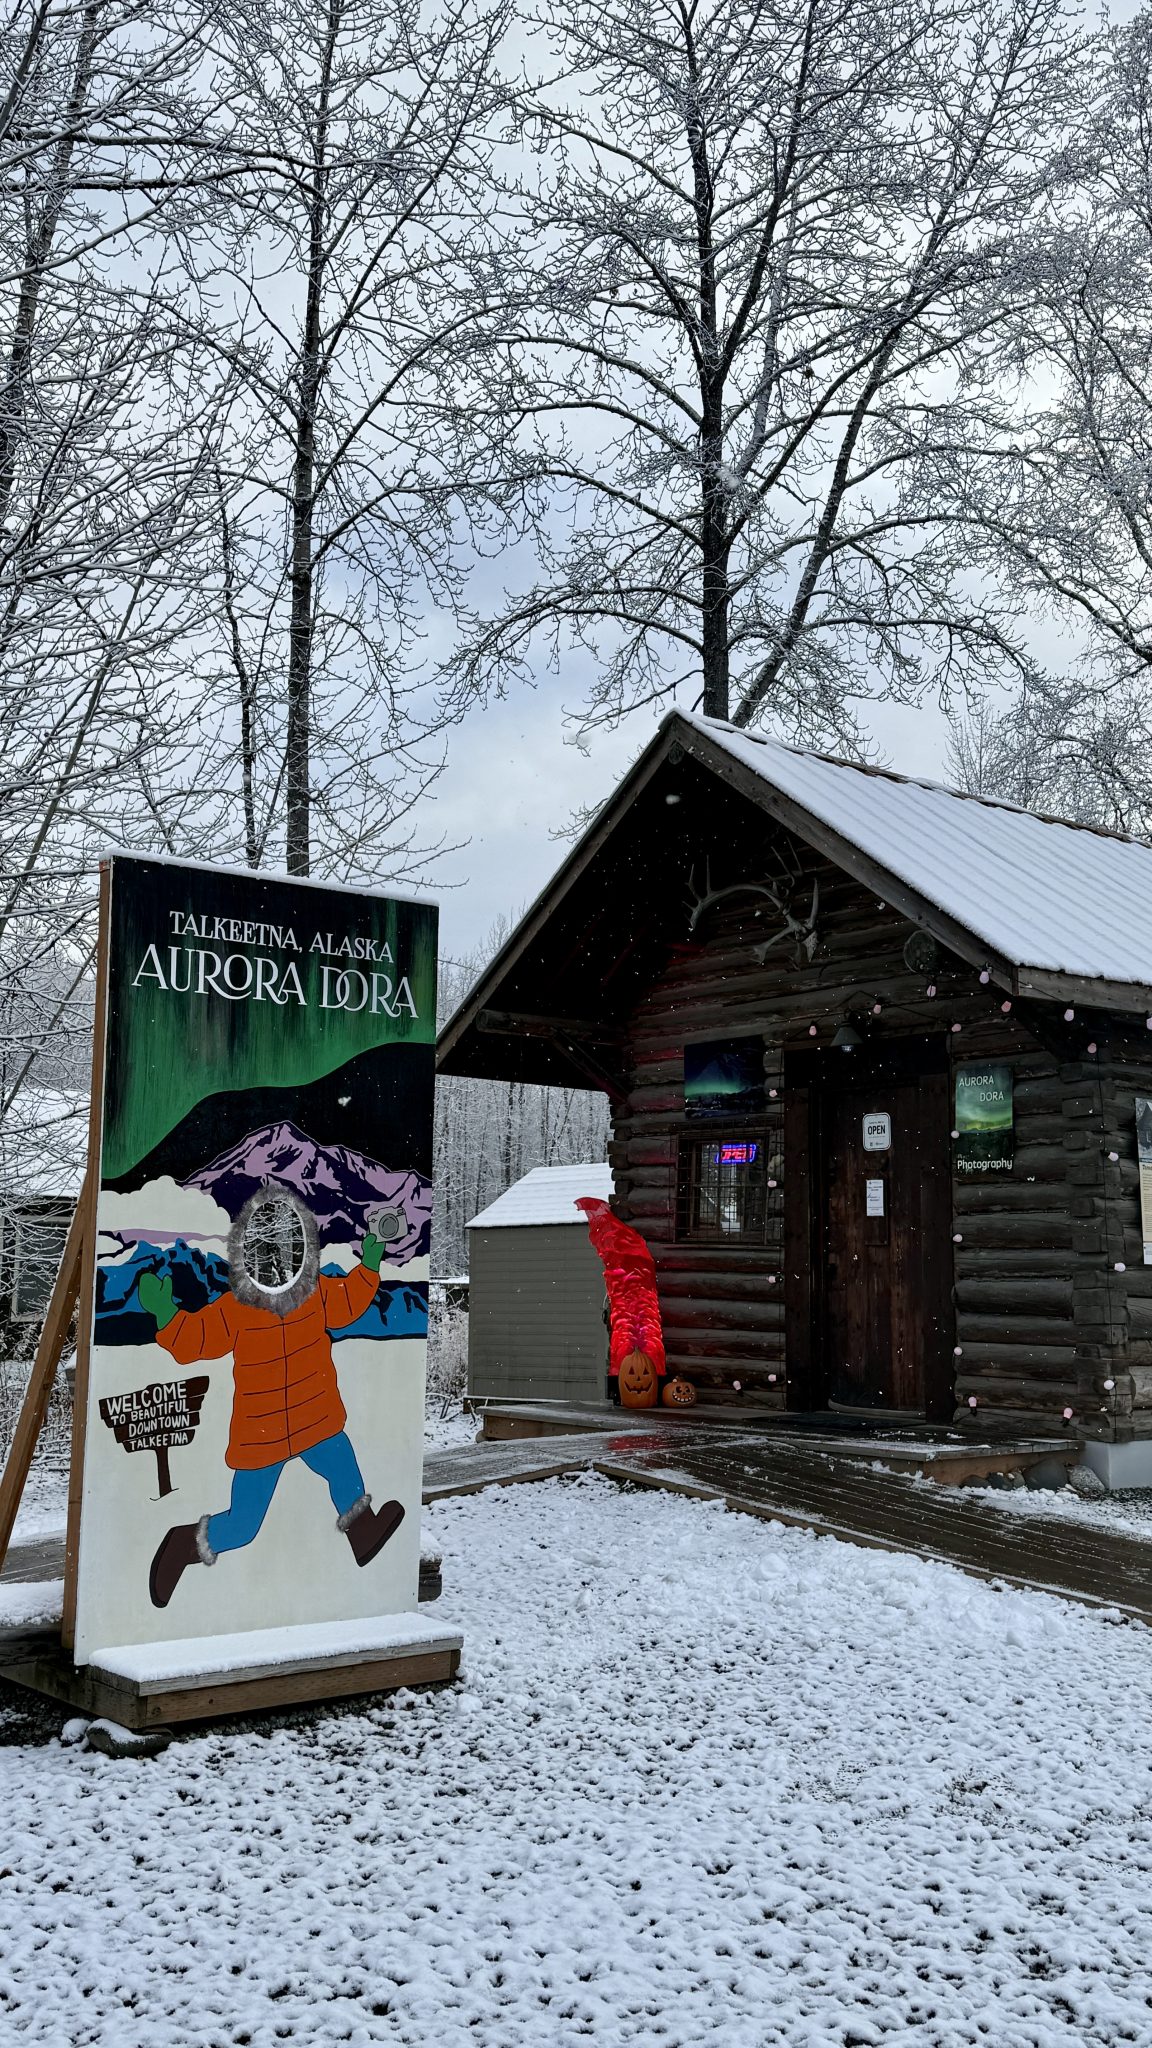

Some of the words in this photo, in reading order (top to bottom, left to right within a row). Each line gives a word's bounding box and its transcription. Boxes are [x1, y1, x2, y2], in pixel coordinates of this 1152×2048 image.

[169, 910, 303, 953] TALKEETNA,
[309, 931, 394, 963] ALASKA
[131, 943, 308, 1006] AURORA
[319, 965, 419, 1019] DORA
[959, 1075, 994, 1087] AURORA
[980, 1091, 1004, 1102] DORA
[867, 1124, 886, 1136] OPEN
[957, 1157, 1013, 1172] Photography
[106, 1381, 187, 1416] WELCOME
[110, 1415, 126, 1426] TO
[131, 1399, 190, 1421] BEAUTIFUL
[129, 1432, 189, 1451] TALKEETNA
